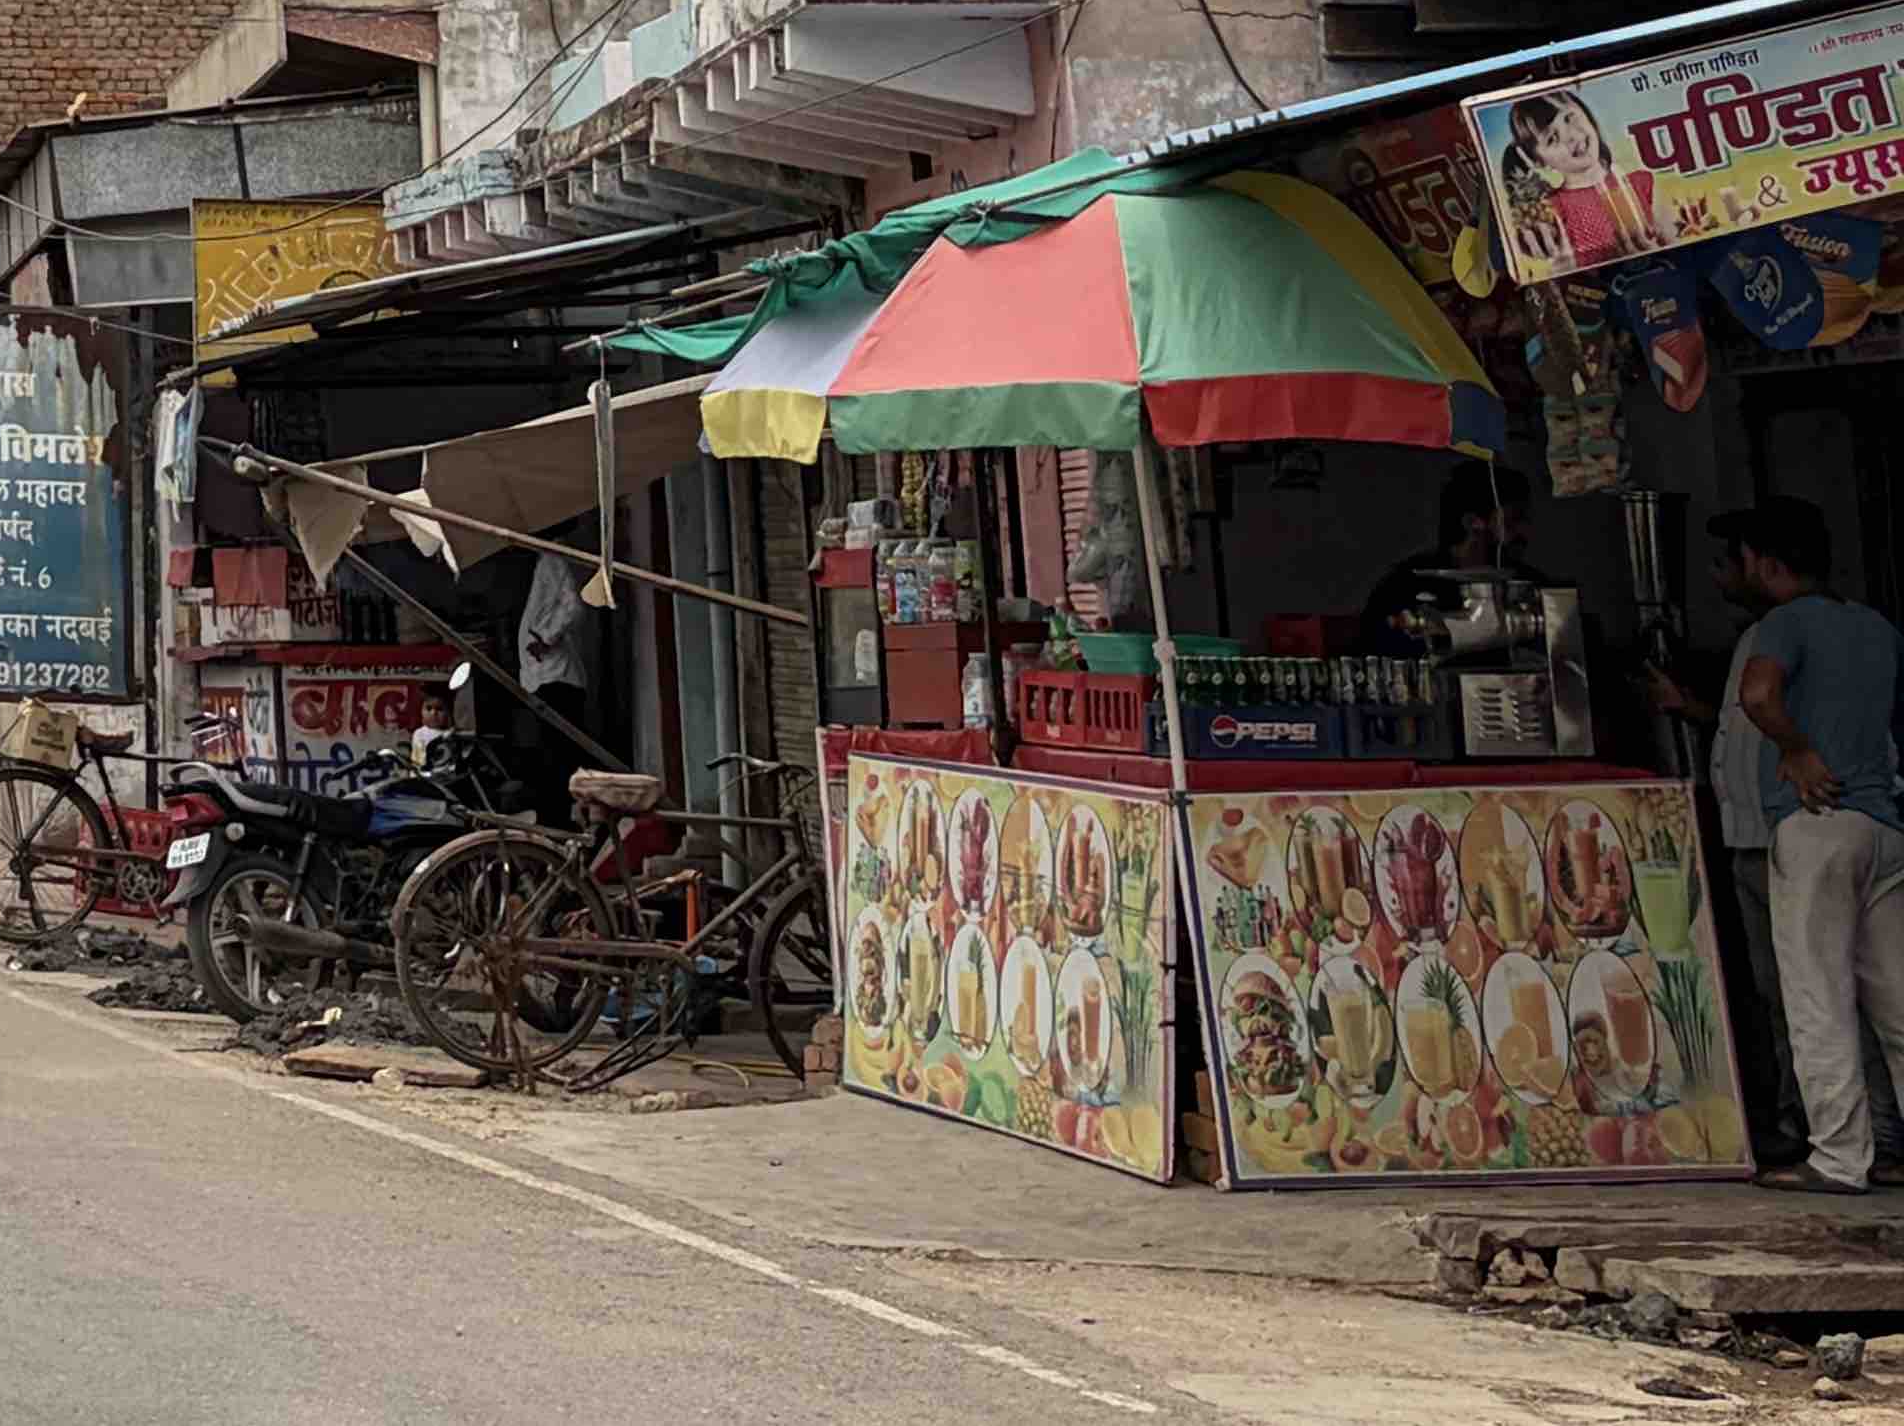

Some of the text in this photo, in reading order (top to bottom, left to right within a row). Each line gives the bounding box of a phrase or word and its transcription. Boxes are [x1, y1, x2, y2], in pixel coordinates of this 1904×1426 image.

[1628, 63, 1892, 174] पण्डित
[1758, 176, 1788, 207] &
[15, 477, 87, 507] महावर
[37, 566, 52, 590] 6
[1239, 721, 1319, 742] PEPSI
